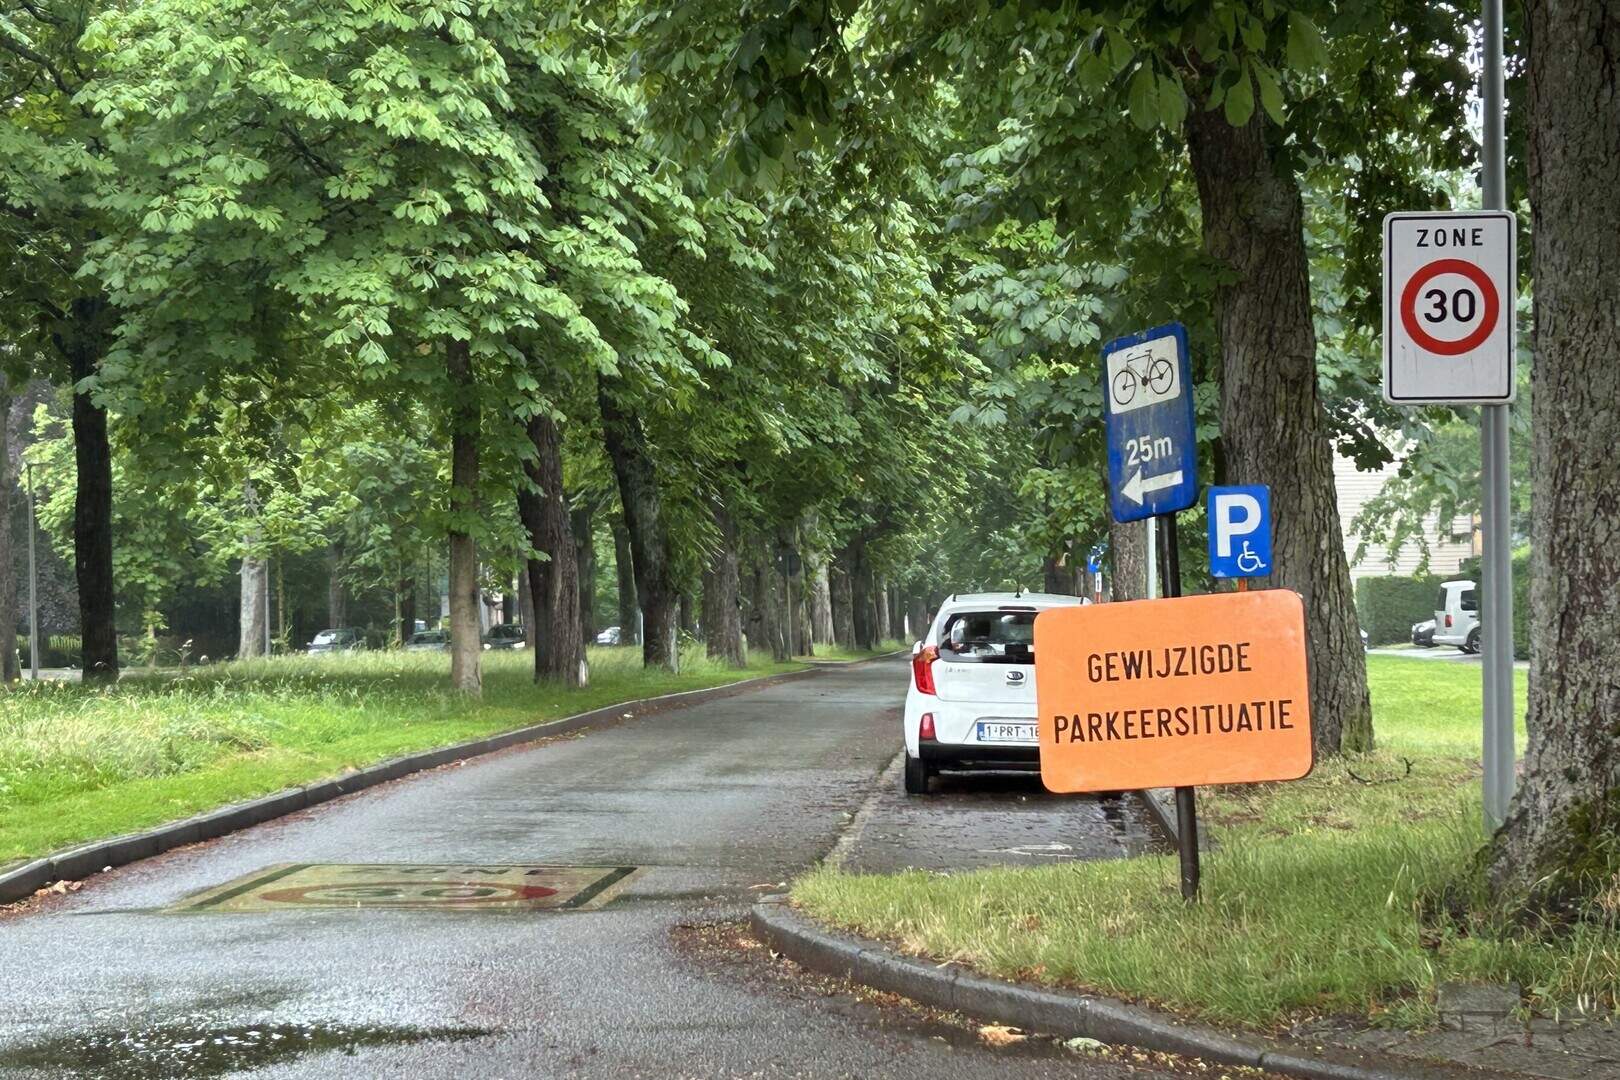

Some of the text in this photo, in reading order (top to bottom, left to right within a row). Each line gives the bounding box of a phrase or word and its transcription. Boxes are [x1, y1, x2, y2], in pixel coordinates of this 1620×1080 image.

[1416, 228, 1484, 248] ZONE
[1423, 288, 1476, 323] 30
[1125, 435, 1173, 467] 25m
[1215, 493, 1262, 558] P
[1087, 642, 1252, 683] GEWIJZIGDE
[1054, 699, 1294, 744] PARKEERSITUATIE
